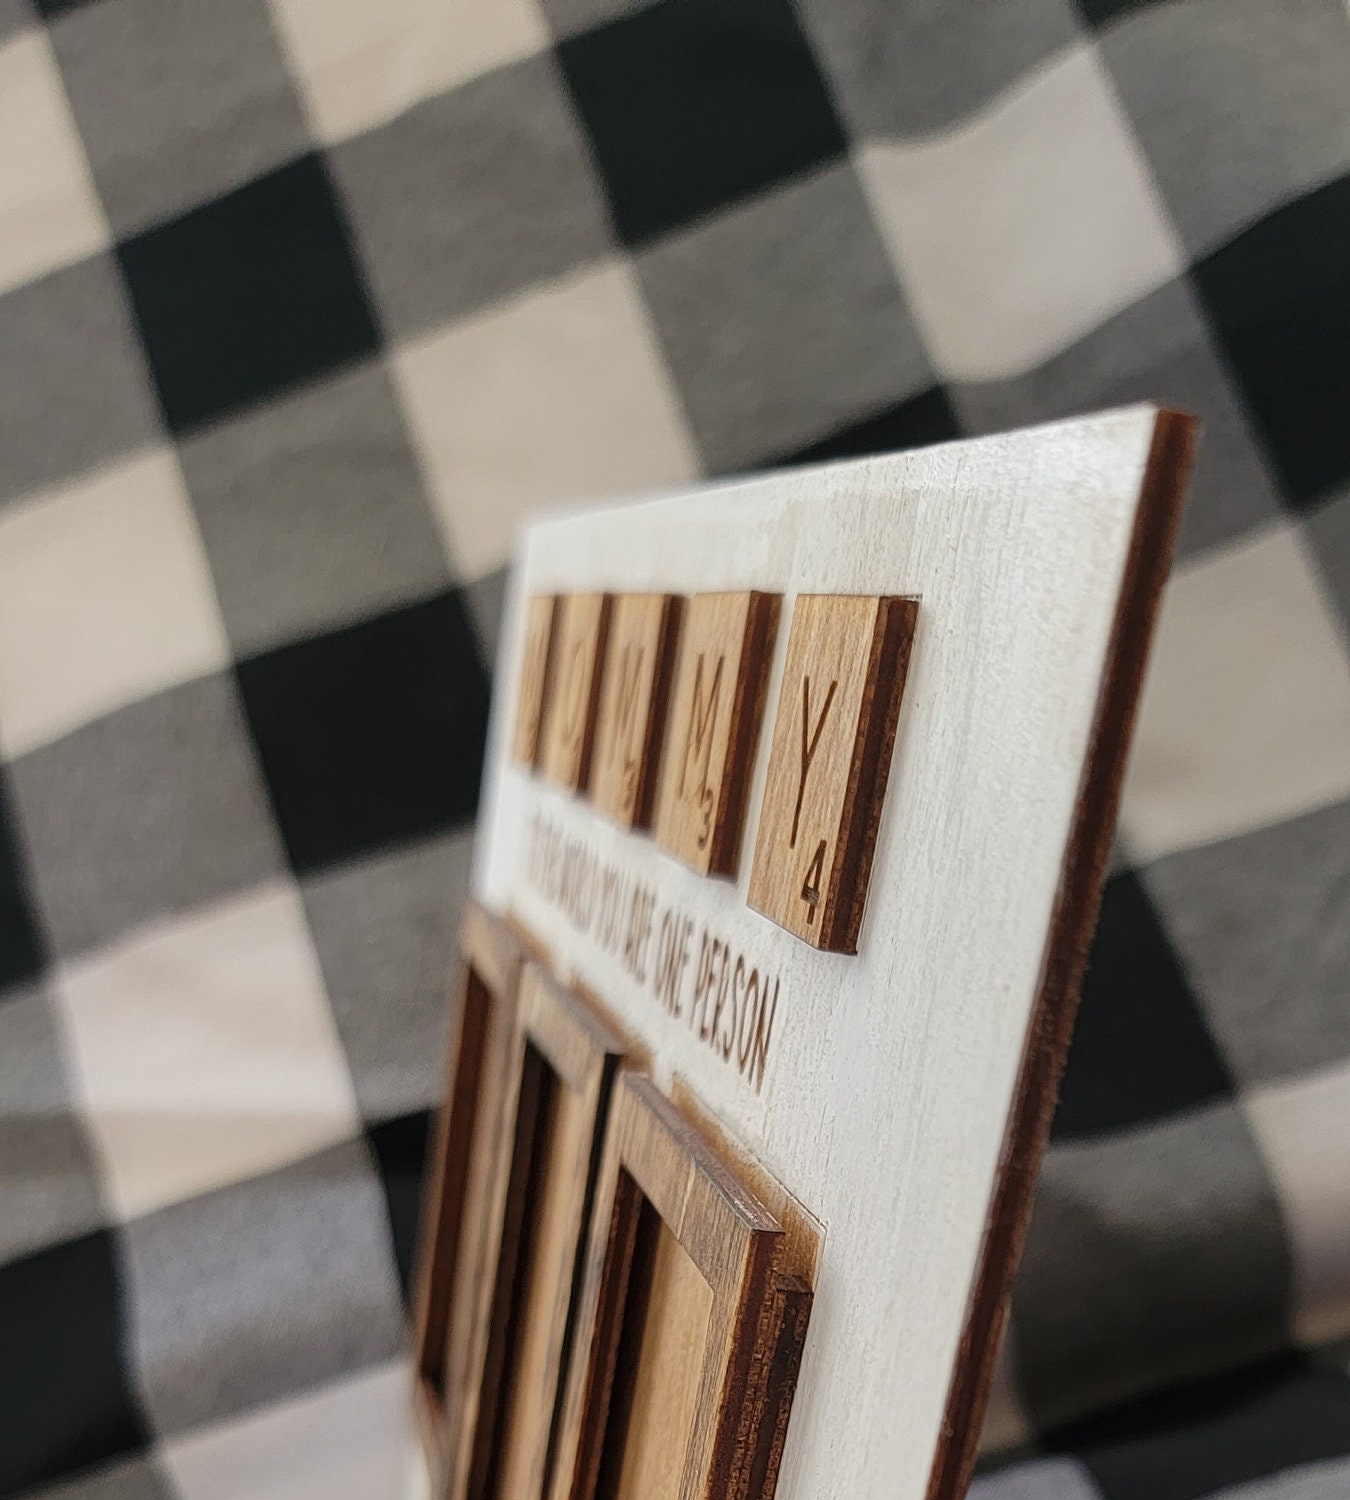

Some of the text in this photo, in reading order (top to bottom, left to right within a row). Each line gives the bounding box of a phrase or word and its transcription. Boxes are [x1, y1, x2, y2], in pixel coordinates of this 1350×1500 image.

[697, 785, 715, 852] 3
[800, 838, 828, 926] 4
[626, 874, 657, 987] ARE
[655, 902, 696, 1020] ONE
[690, 927, 781, 1098] PERSON
